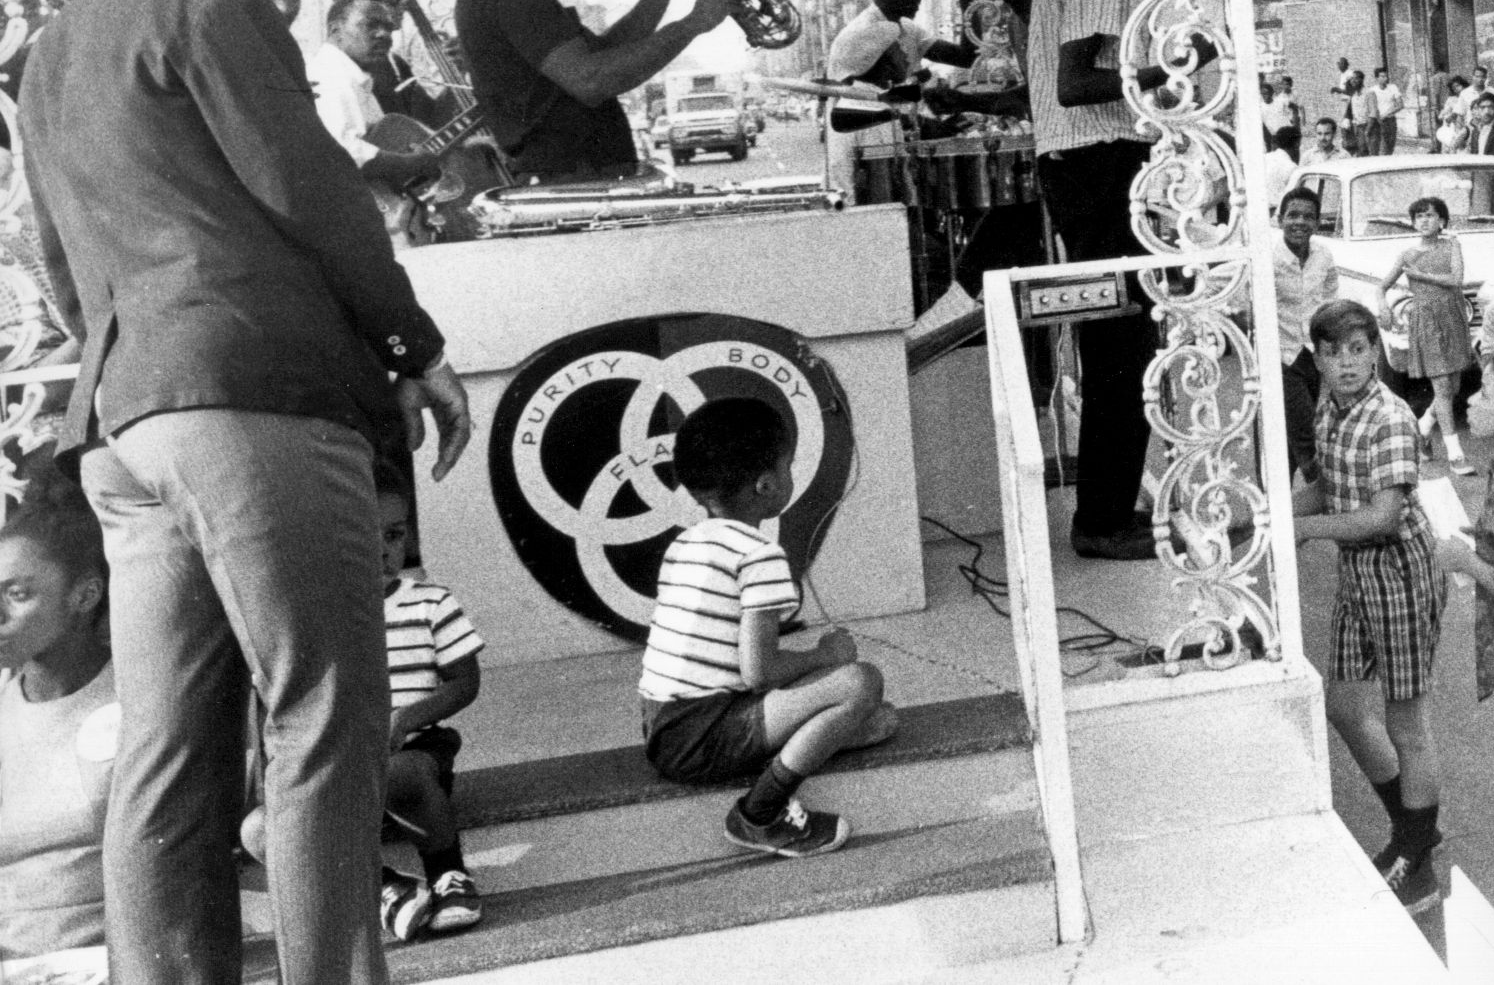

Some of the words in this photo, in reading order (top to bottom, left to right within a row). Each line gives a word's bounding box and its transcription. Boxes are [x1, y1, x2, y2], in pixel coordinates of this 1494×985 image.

[520, 356, 622, 446] PURITY
[728, 347, 809, 402] BODY
[610, 441, 673, 482] FLA
